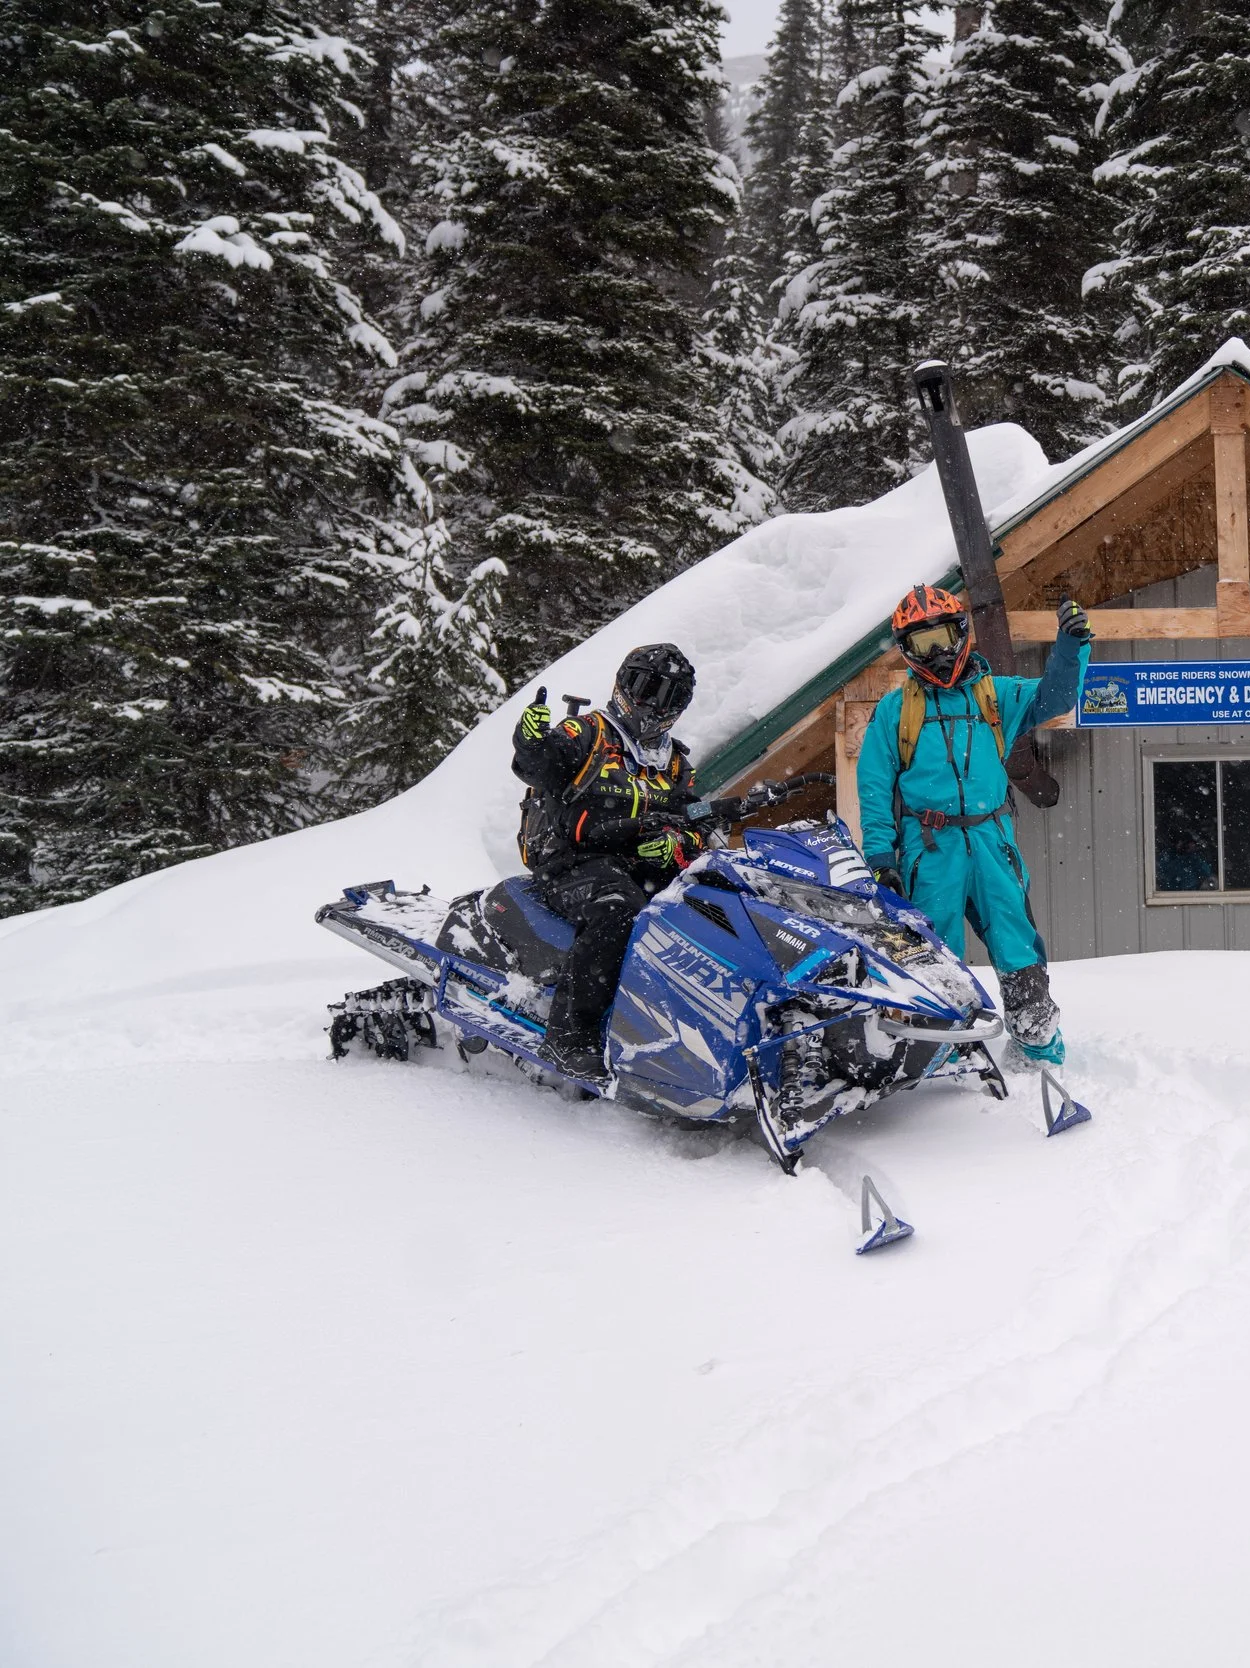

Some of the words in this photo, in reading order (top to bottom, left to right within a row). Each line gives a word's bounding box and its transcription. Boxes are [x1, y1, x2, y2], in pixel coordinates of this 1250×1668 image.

[1134, 671, 1148, 681] TR
[1149, 671, 1179, 680] RIDGE
[1181, 671, 1216, 680] RIDERS
[1136, 685, 1225, 705] EMERGENCY
[1229, 685, 1240, 704] &
[1212, 710, 1230, 719] USE
[1231, 710, 1243, 718] AT
[783, 917, 821, 939] FXR
[775, 929, 808, 952] YAMAHA
[668, 930, 734, 978] MOUNTAIN
[452, 961, 500, 990] HOVER
